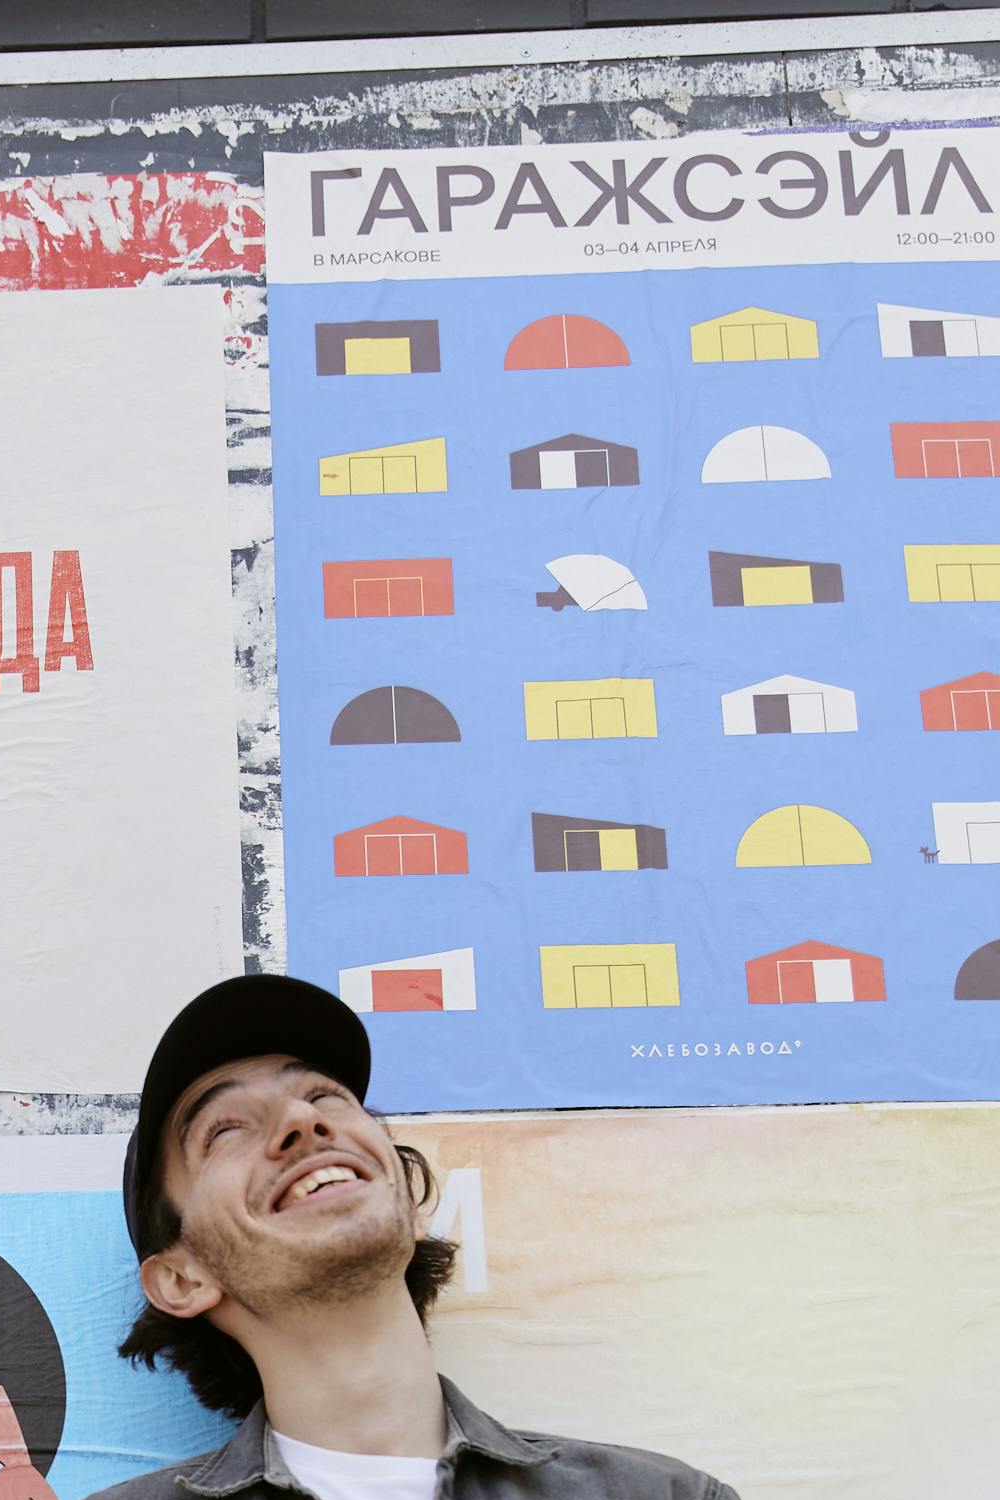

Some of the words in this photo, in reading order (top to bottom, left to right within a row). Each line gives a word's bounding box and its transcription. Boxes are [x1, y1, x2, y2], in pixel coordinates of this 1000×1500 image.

[310, 130, 994, 237] ГАРАЖСЭЙЛ
[645, 238, 717, 253] АПРЕЛЯ
[313, 254, 325, 267] В
[330, 250, 441, 266] МАРСАКОВЕ
